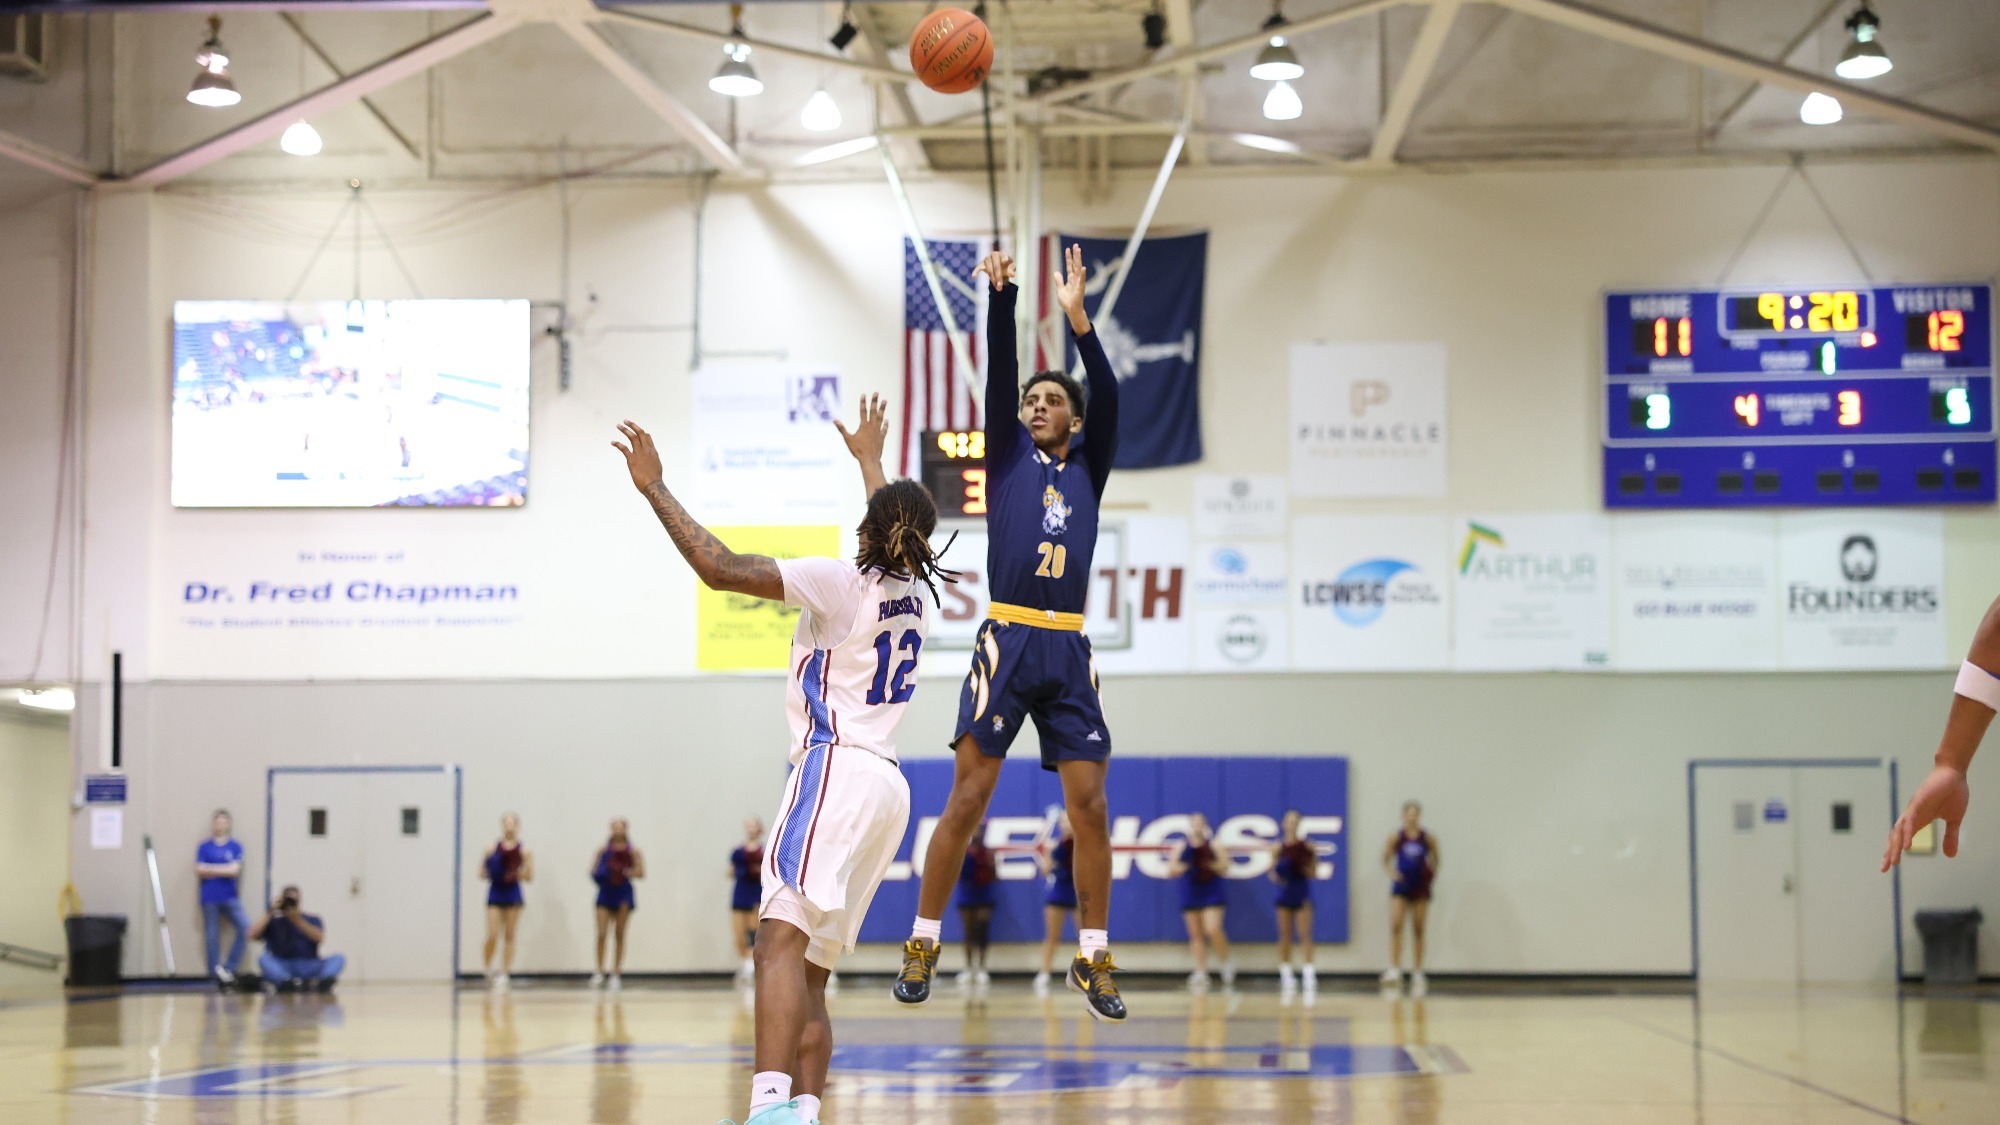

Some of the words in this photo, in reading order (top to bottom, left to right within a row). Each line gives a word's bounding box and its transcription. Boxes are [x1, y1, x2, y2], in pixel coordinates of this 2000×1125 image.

[1758, 291, 1859, 332] 9:20
[1892, 288, 1974, 313] VISITOR
[1655, 317, 1691, 356] 11
[1927, 310, 1964, 351] 12
[1821, 341, 1836, 375] 1
[1646, 394, 1670, 430] 3
[1735, 393, 1758, 427] 4
[1838, 391, 1861, 425] 3
[1946, 388, 1971, 424] 5
[937, 431, 985, 458] 9:2
[1299, 423, 1440, 444] PINNACLE
[1035, 542, 1066, 579] 20
[1475, 554, 1597, 583] ARTHUR
[184, 582, 234, 602] Dr.
[250, 581, 333, 602] Fred
[347, 580, 519, 606] Chapman
[941, 566, 1184, 621] STH
[1303, 581, 1386, 607] LCWSC
[1789, 582, 1938, 614] FOUNDERS
[866, 629, 922, 705] 12
